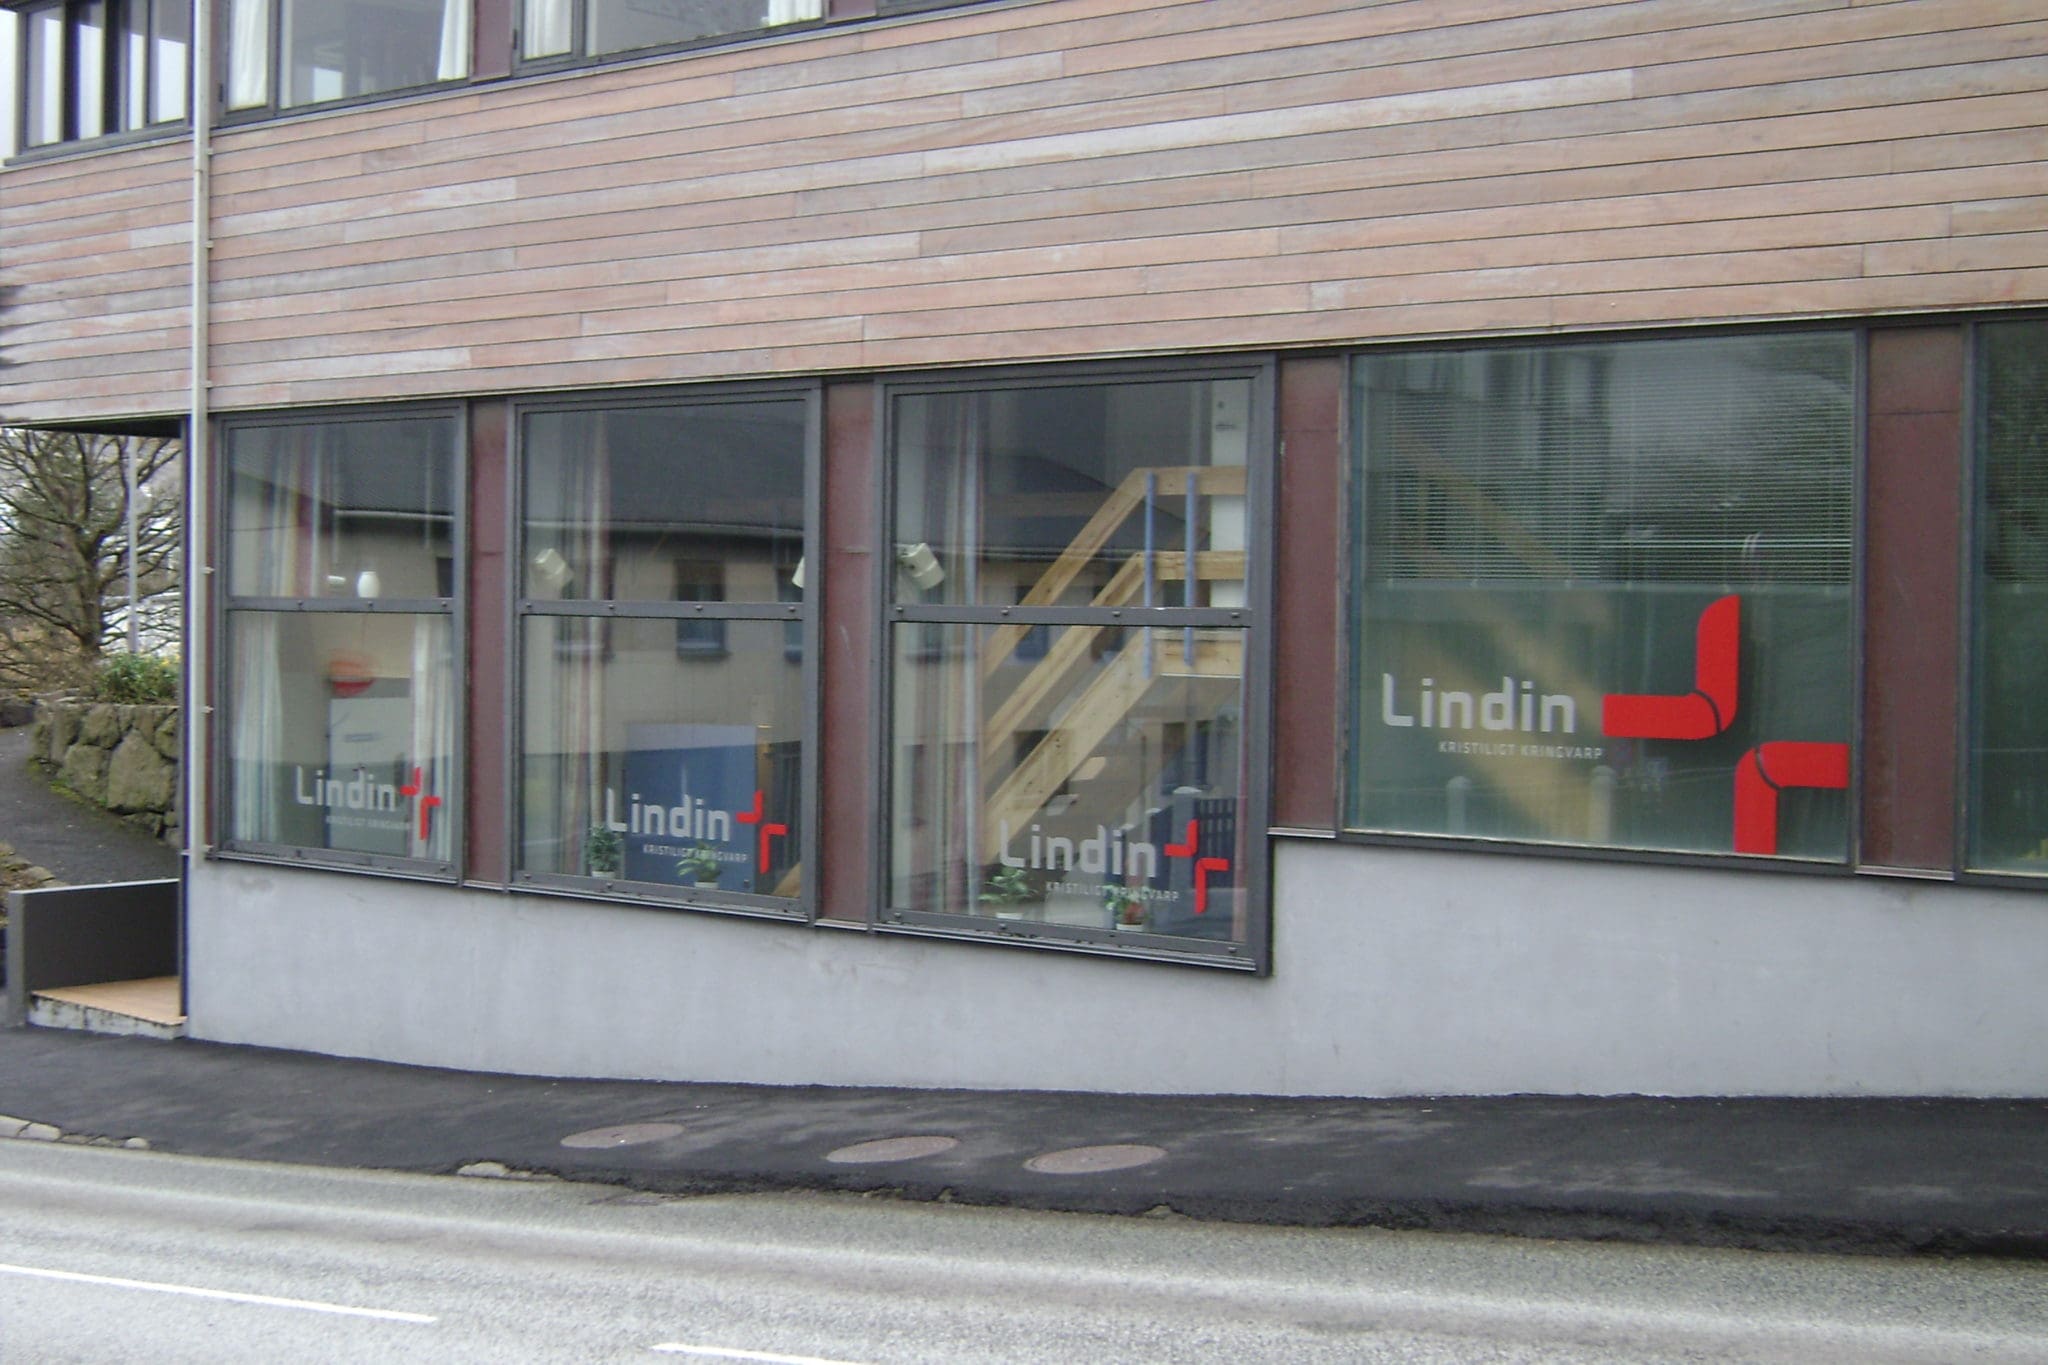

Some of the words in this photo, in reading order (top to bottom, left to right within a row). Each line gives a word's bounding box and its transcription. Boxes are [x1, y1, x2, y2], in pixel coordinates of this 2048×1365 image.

[1382, 672, 1575, 733] Lindin
[1438, 740, 1516, 756] KRISTILIGT
[297, 765, 396, 812] Lindin
[607, 787, 731, 842] Lindin
[1001, 819, 1156, 878] Lindin
